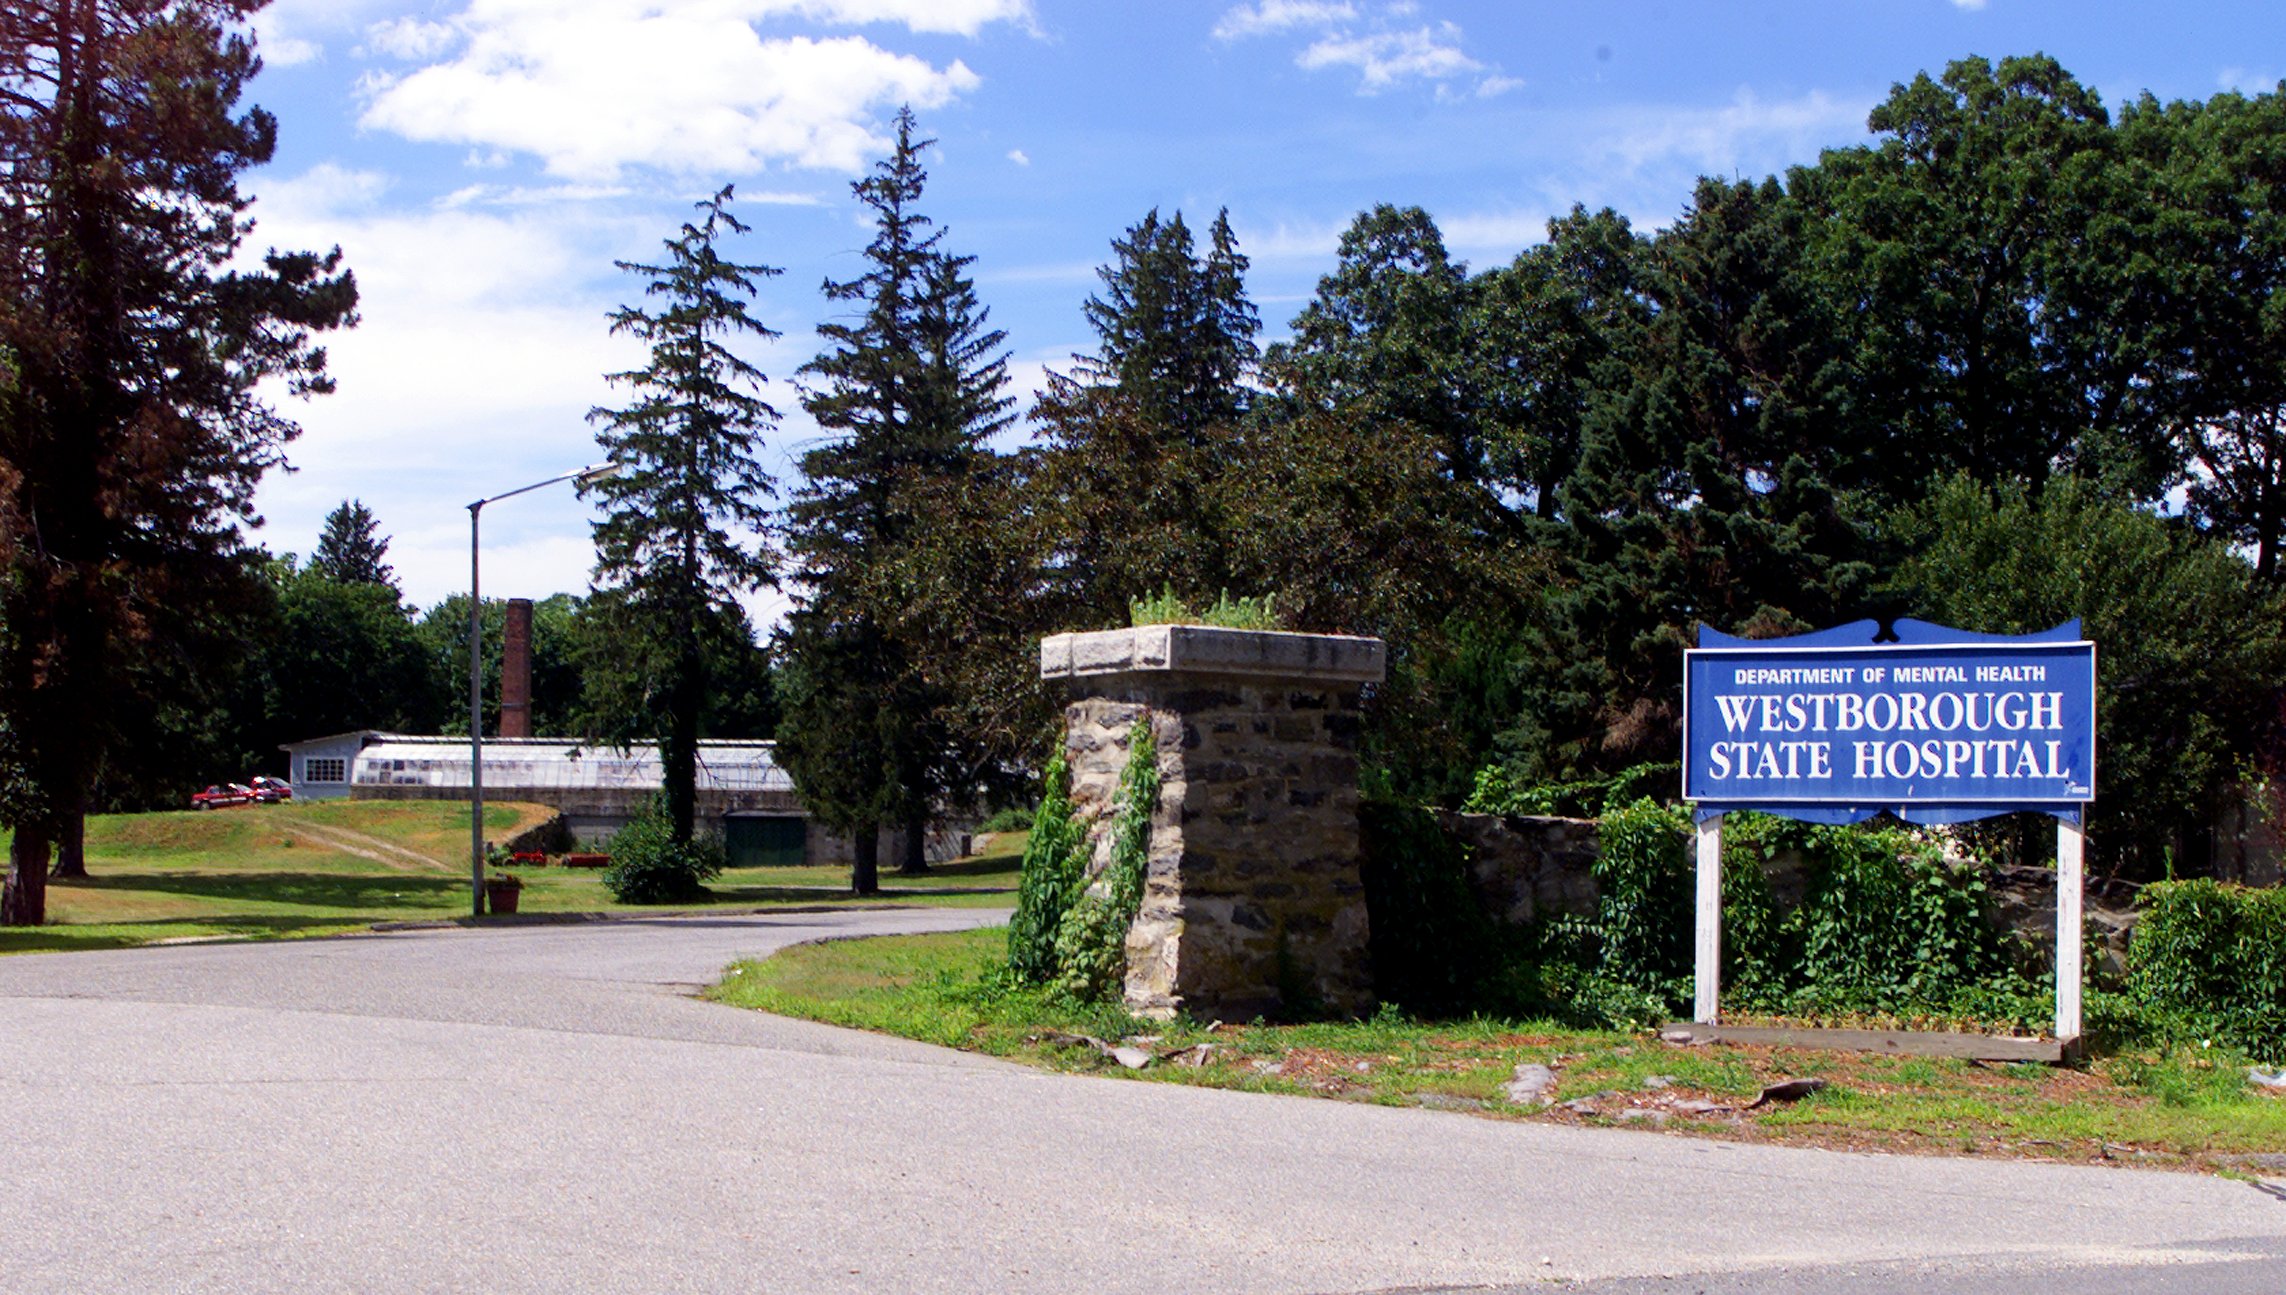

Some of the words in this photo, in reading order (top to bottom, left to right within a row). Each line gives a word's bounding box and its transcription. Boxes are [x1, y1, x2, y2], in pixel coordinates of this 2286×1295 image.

[1735, 667, 1854, 685] DEPARTMENT
[1862, 667, 1886, 684] OF
[1893, 666, 1967, 683] MENTAL
[1975, 665, 2046, 682] HEALTH
[1714, 691, 2063, 732] WESTBOROUGH
[1708, 741, 1832, 780] STATE
[1852, 740, 2070, 779] HOSPITAL
